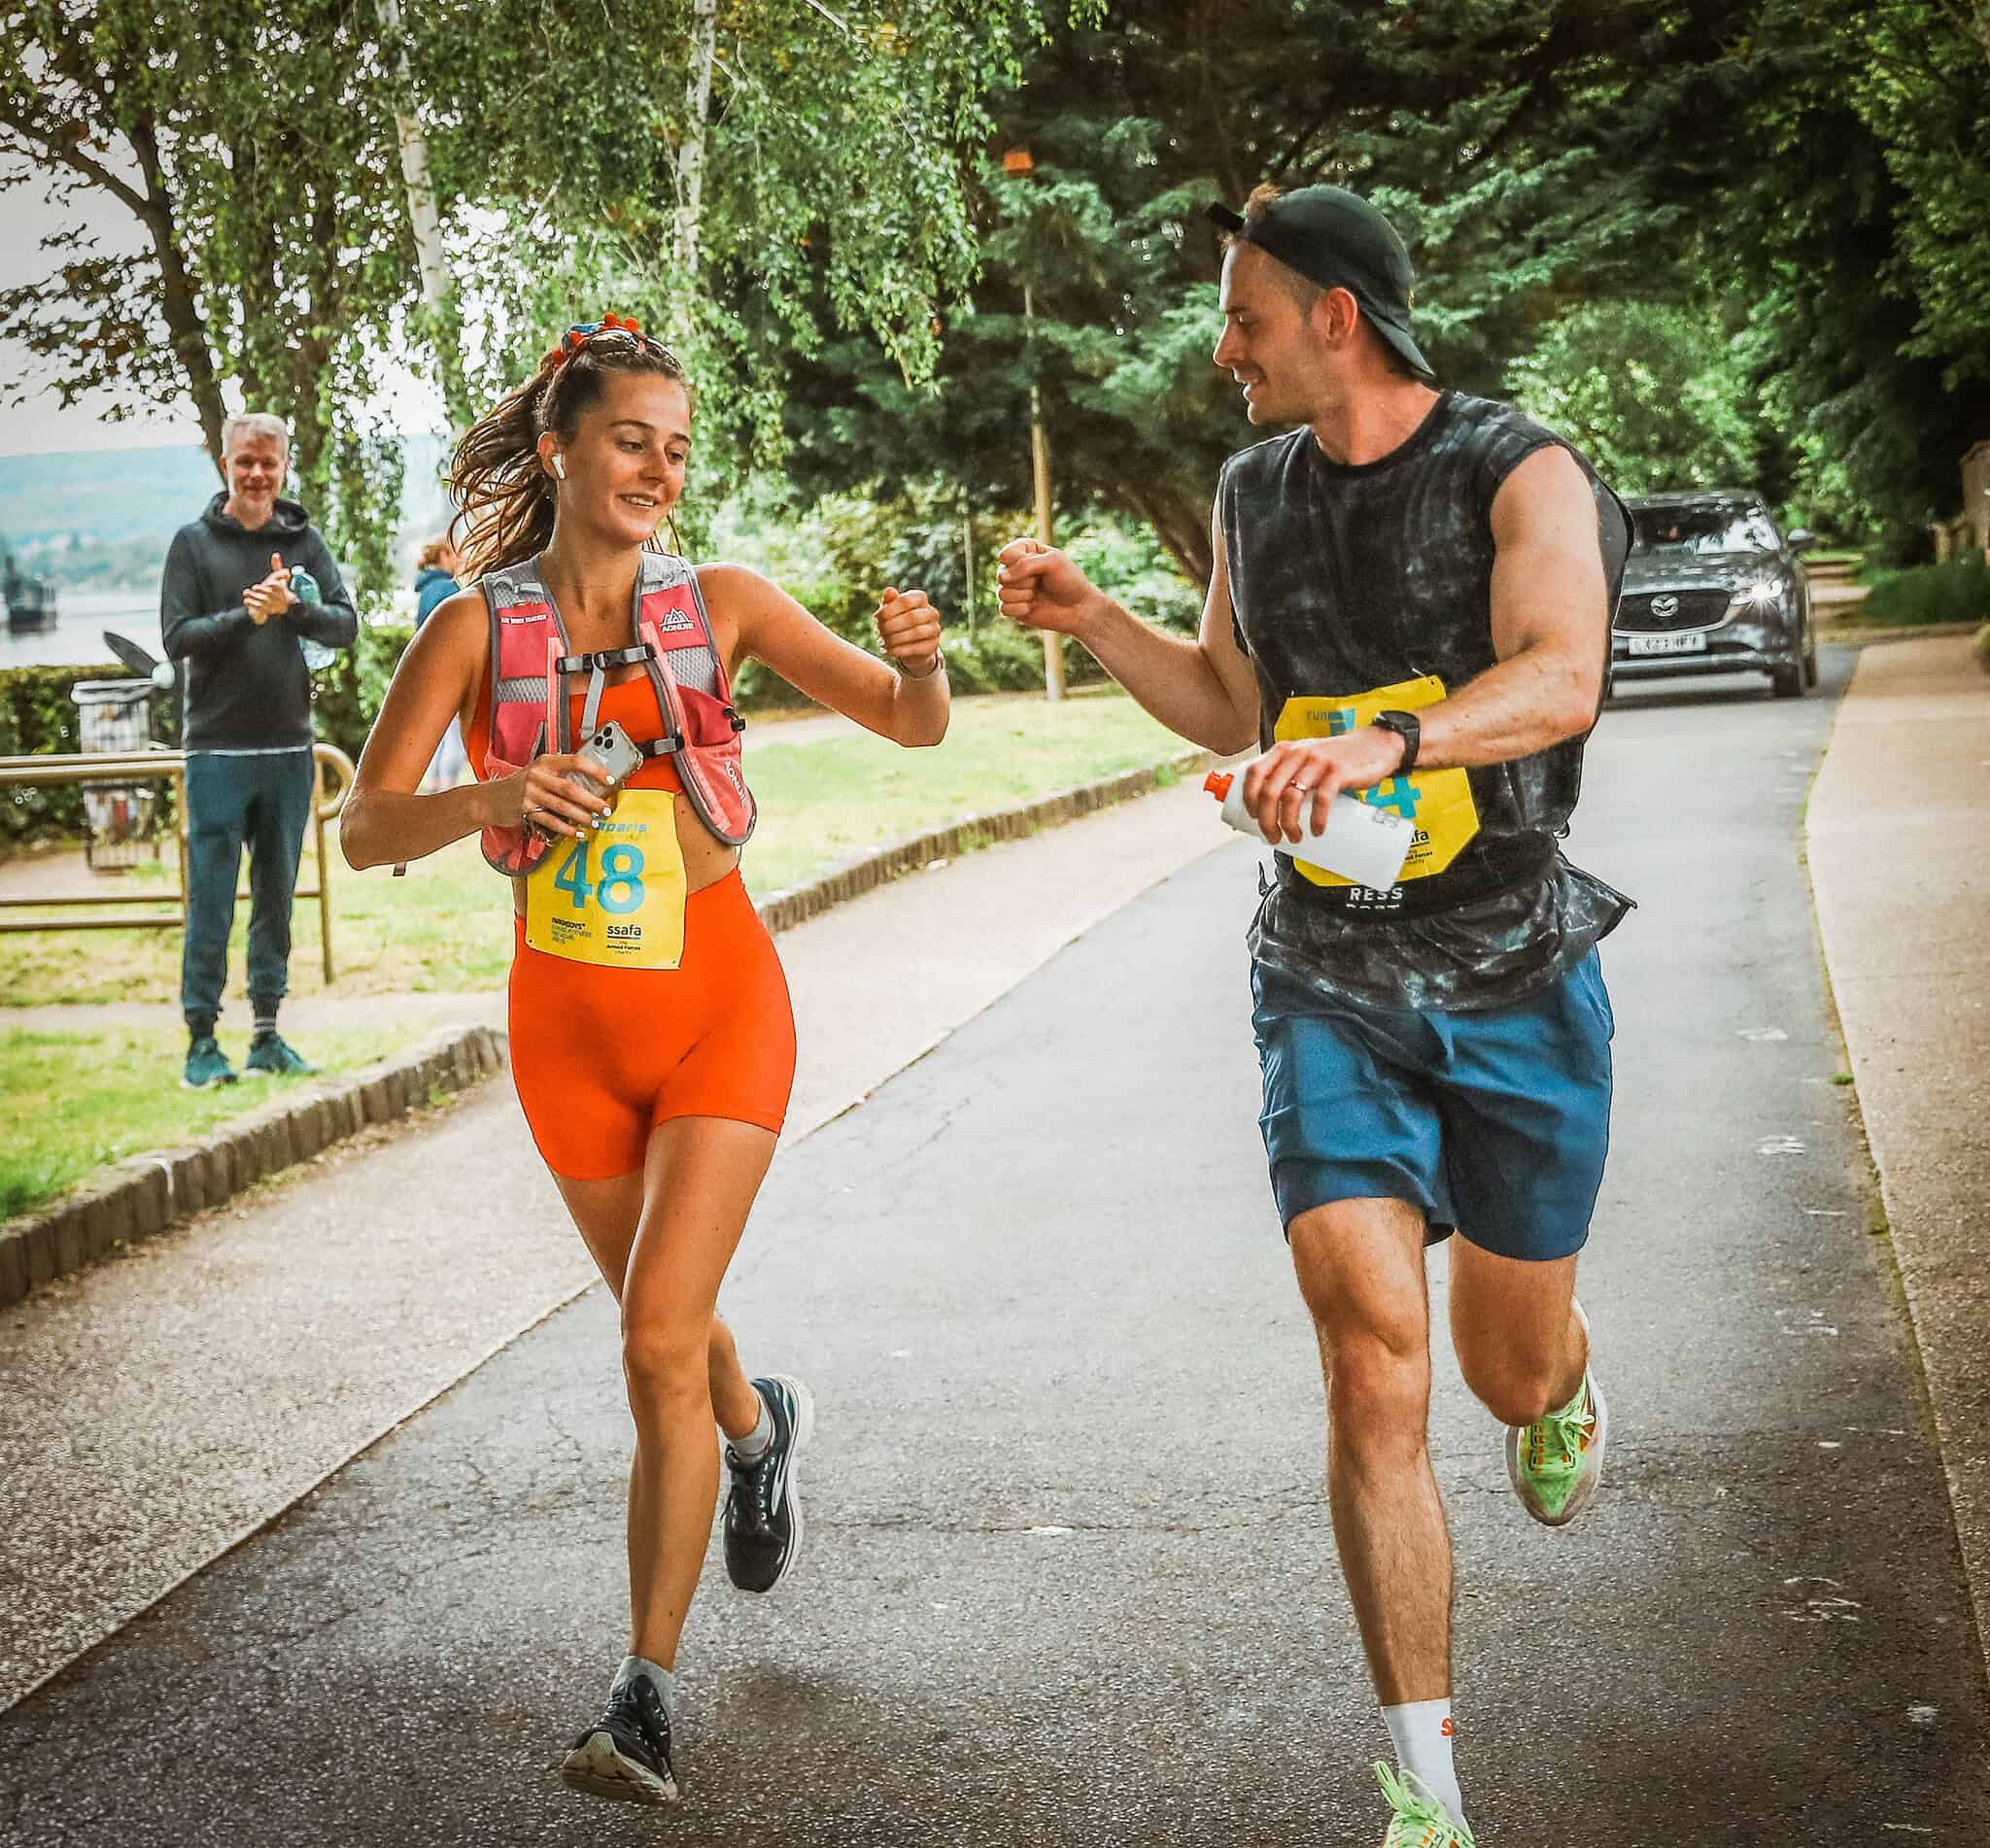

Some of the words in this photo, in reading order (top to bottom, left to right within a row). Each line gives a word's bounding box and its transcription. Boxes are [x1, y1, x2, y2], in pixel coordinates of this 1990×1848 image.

[1360, 776, 1422, 819] 4
[554, 840, 645, 914] 48
[606, 924, 641, 936] ssafa
